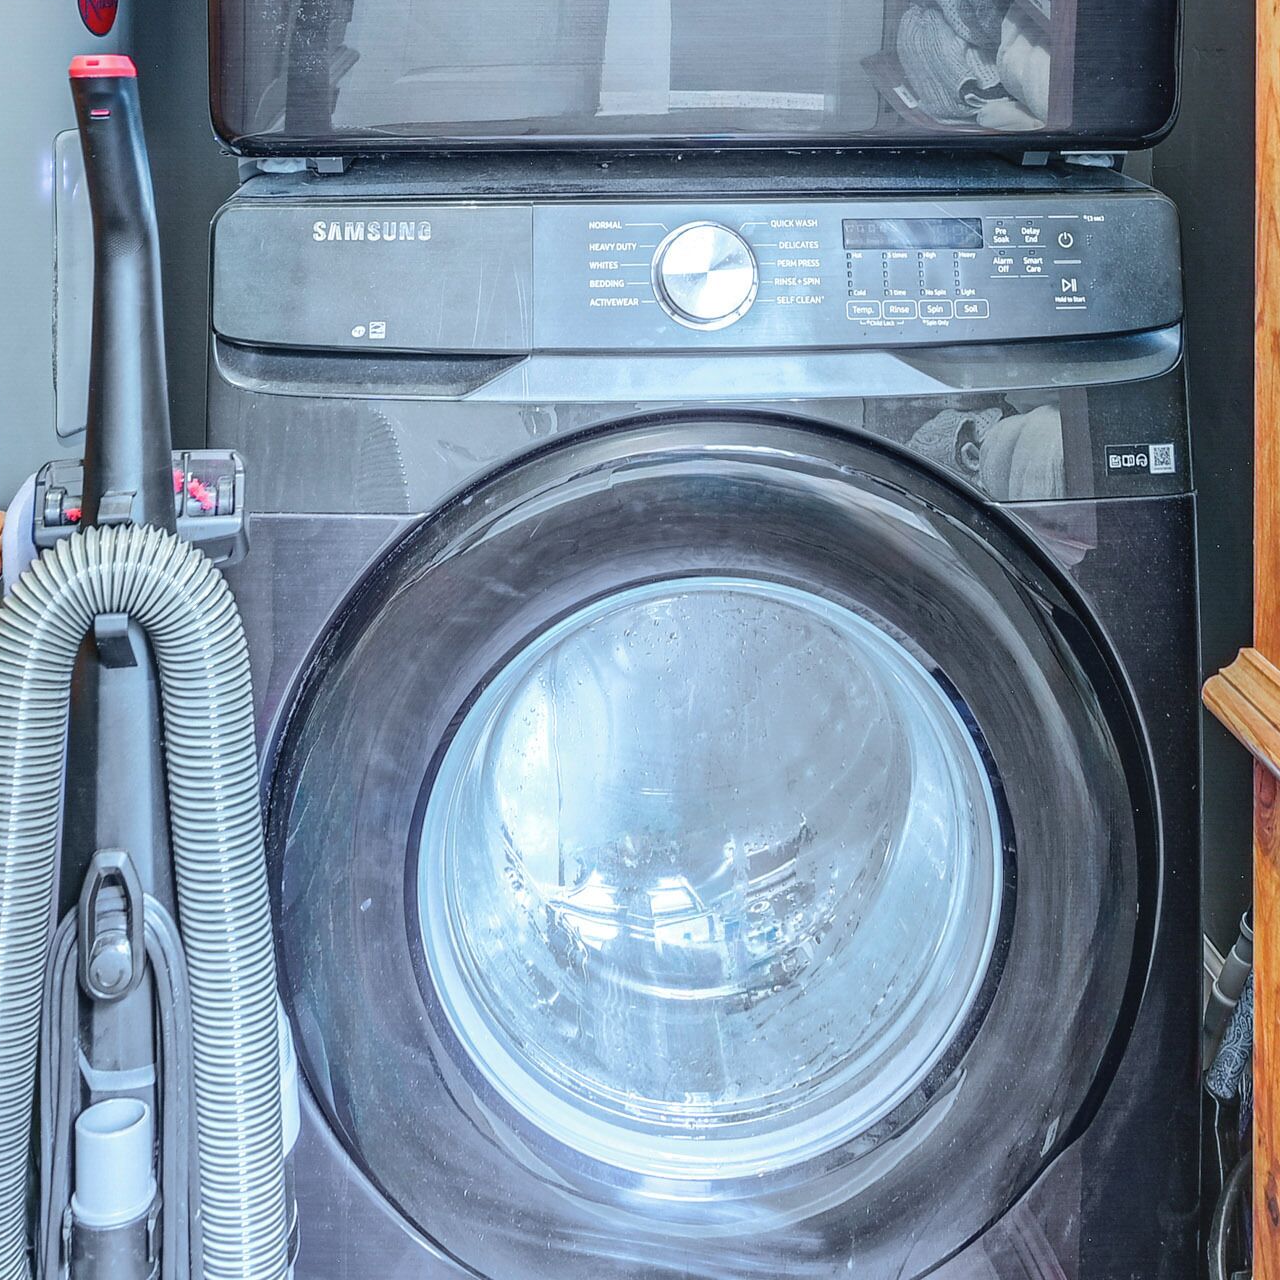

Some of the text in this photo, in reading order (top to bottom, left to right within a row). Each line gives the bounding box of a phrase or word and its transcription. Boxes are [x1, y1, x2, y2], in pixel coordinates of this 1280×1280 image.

[588, 221, 622, 229] NORMAL
[770, 220, 794, 228] QUICK
[312, 221, 432, 241] SAMSUNG
[995, 227, 1007, 235] Pre
[1021, 226, 1040, 236] Delay
[589, 242, 637, 251] HEAVY DUTY
[778, 241, 819, 249] DELICATES
[777, 260, 820, 268] PERM PRESS
[993, 257, 1014, 265] Alarm
[1023, 257, 1043, 265] Smart
[589, 261, 618, 270] WHITES
[998, 265, 1010, 273] Off
[1026, 265, 1041, 273] Care
[589, 280, 624, 288] BEDDING
[774, 278, 796, 286] RINSE
[803, 278, 821, 286] SPIN
[589, 298, 639, 307] ACTIVEWEAR
[776, 296, 795, 304] SELF
[852, 305, 874, 315] Temp.
[889, 305, 910, 313] Rinse
[927, 304, 944, 314] Spin
[964, 304, 978, 313] Soil
